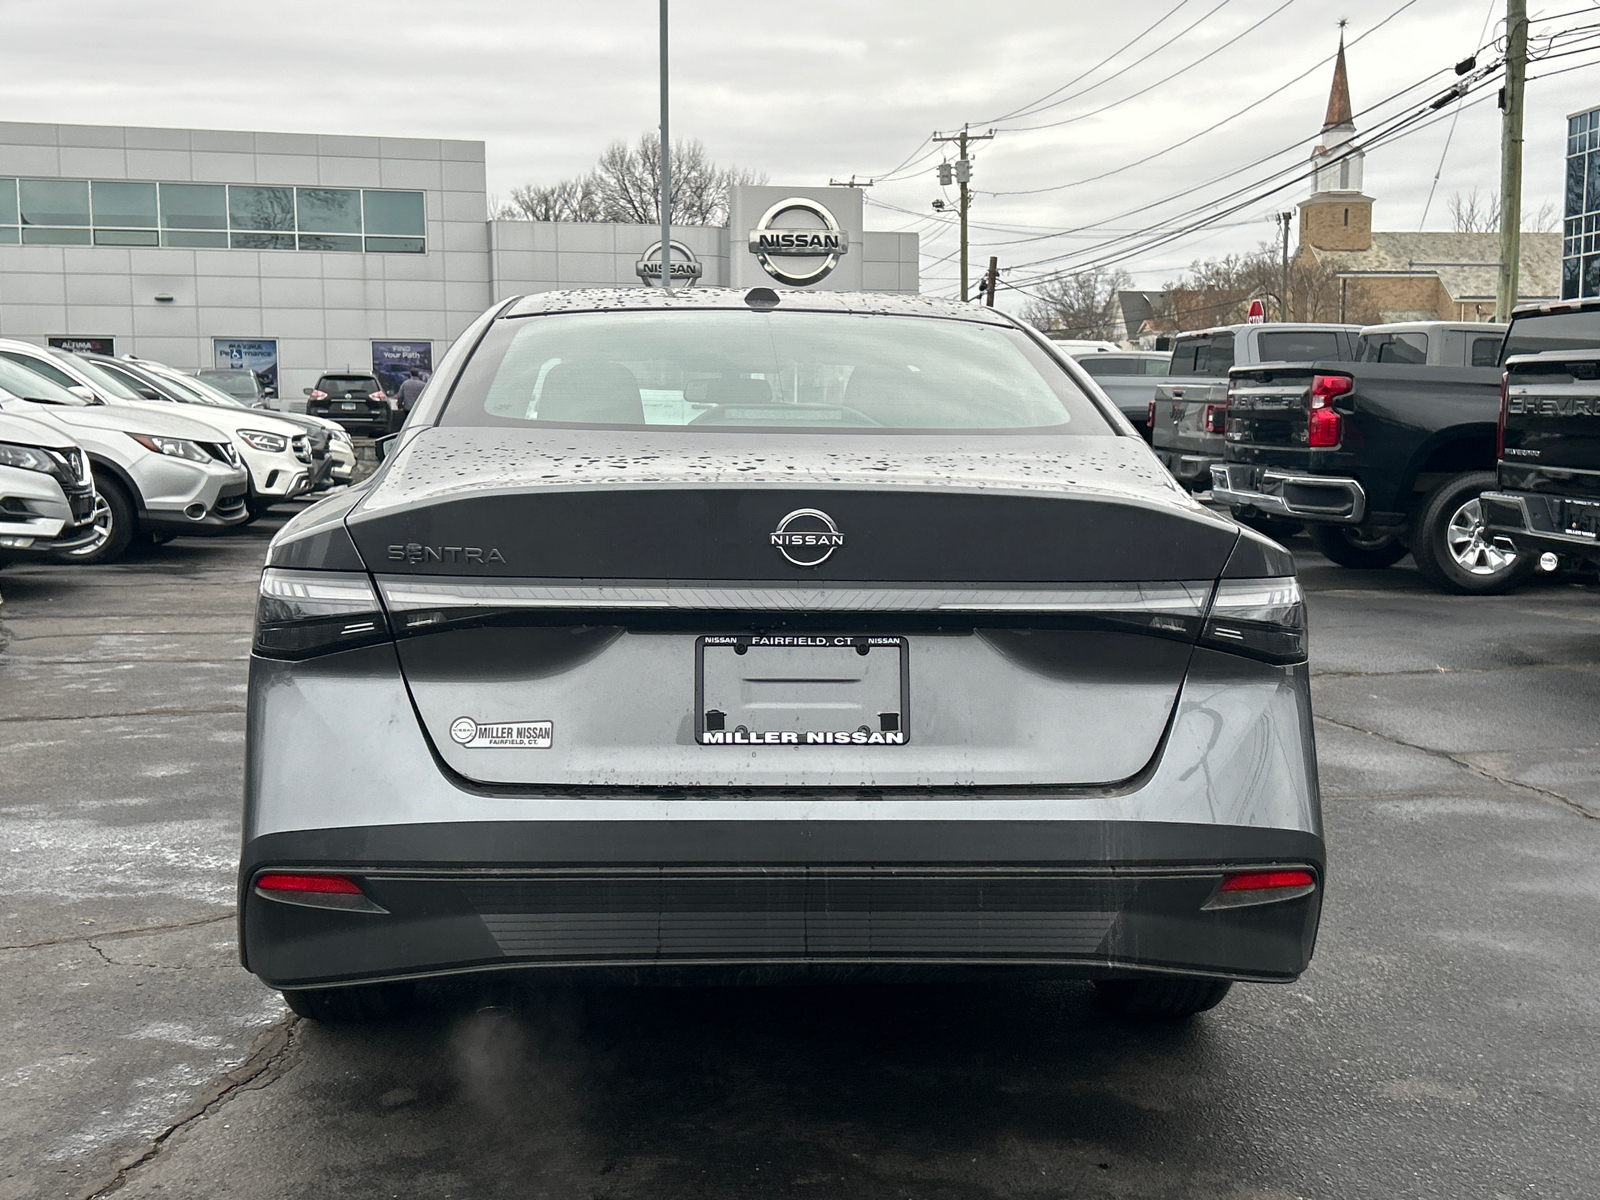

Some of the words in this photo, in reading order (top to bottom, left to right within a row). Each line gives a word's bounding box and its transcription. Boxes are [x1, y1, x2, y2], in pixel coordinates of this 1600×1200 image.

[758, 234, 839, 249] NISSAN
[62, 341, 92, 349] ALTIMA
[771, 535, 844, 545] NISSAN
[387, 544, 506, 564] SENTRA
[704, 636, 738, 644] NISSAN
[751, 636, 830, 647] FAIRFIELD,
[833, 637, 854, 646] CT
[867, 637, 901, 645] NISSAN
[478, 726, 514, 740] MILLER
[516, 726, 551, 740] NISSAN
[703, 731, 799, 744] MILLER
[806, 731, 904, 744] NISSAN
